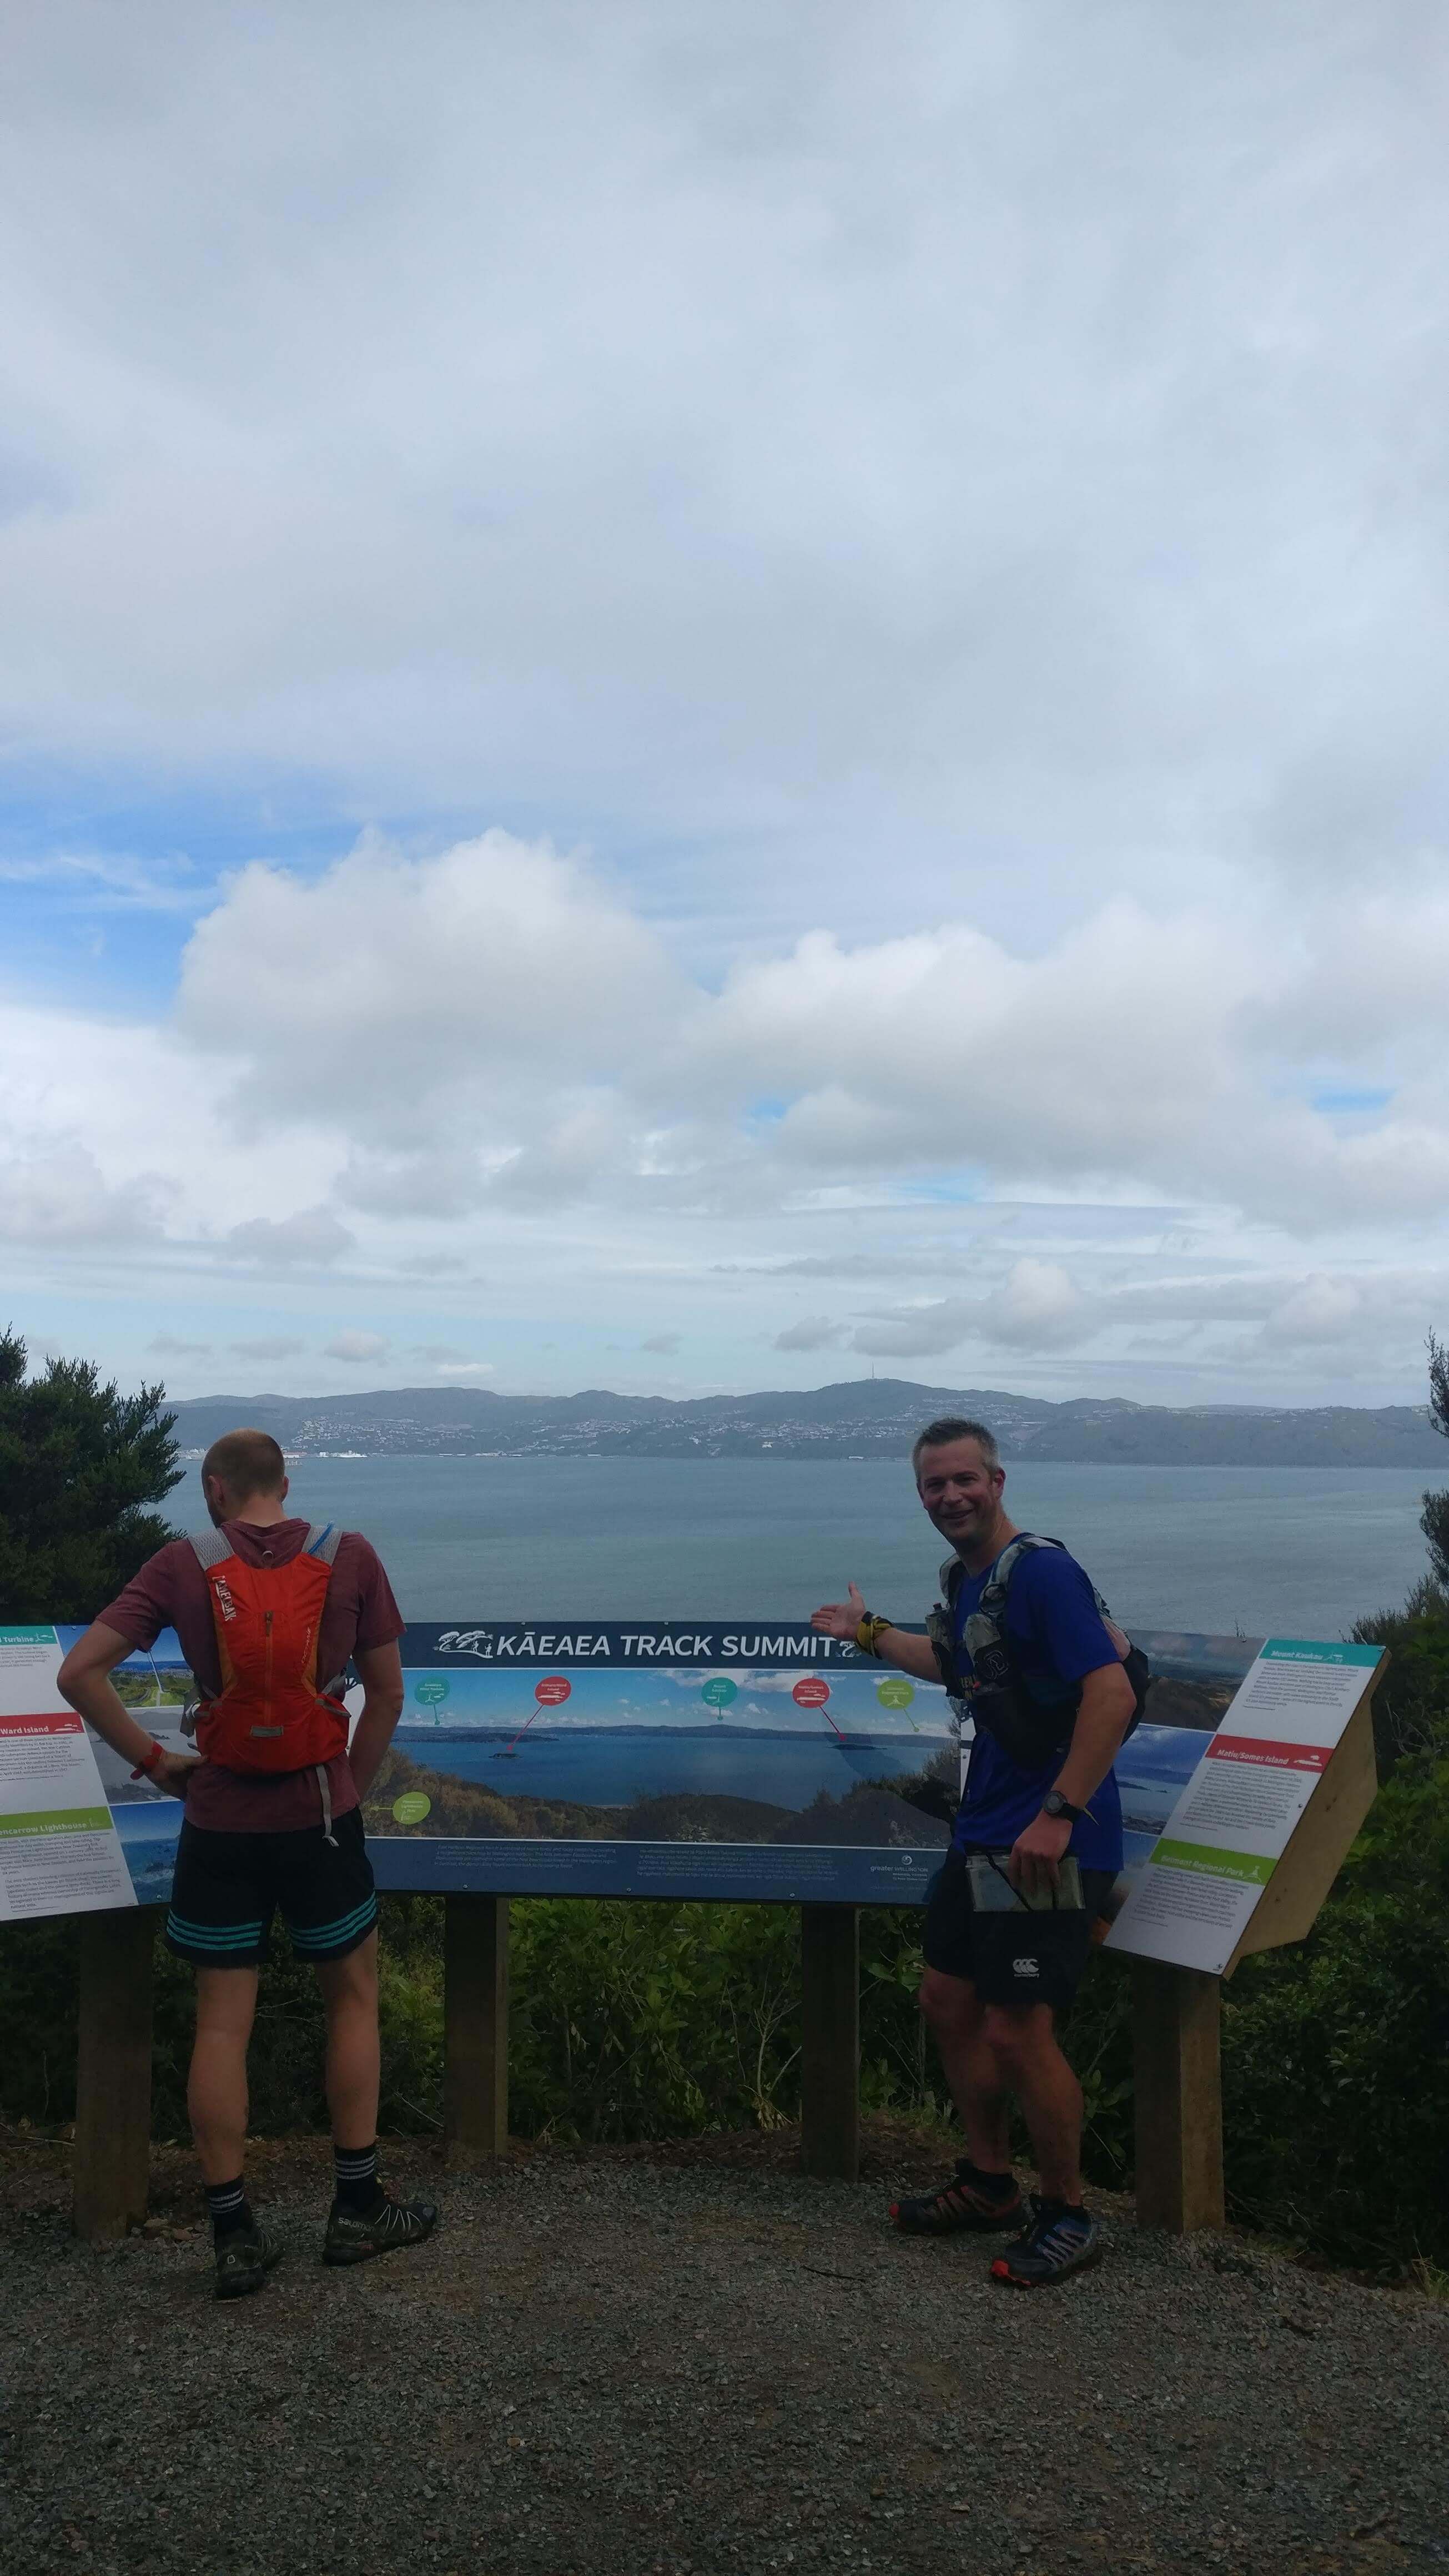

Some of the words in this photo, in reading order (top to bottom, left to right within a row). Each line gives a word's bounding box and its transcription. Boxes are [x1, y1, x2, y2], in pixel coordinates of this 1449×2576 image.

[497, 1632, 610, 1656] KĀEAEA
[620, 1635, 713, 1657] TRACK
[721, 1636, 836, 1657] SUMMIT
[1217, 1749, 1264, 1762] Matiu/Somes
[1265, 1757, 1289, 1765] Island
[40, 1823, 87, 1833] Lighthouse
[1193, 1861, 1225, 1874] Regional
[1226, 1866, 1244, 1877] Park
